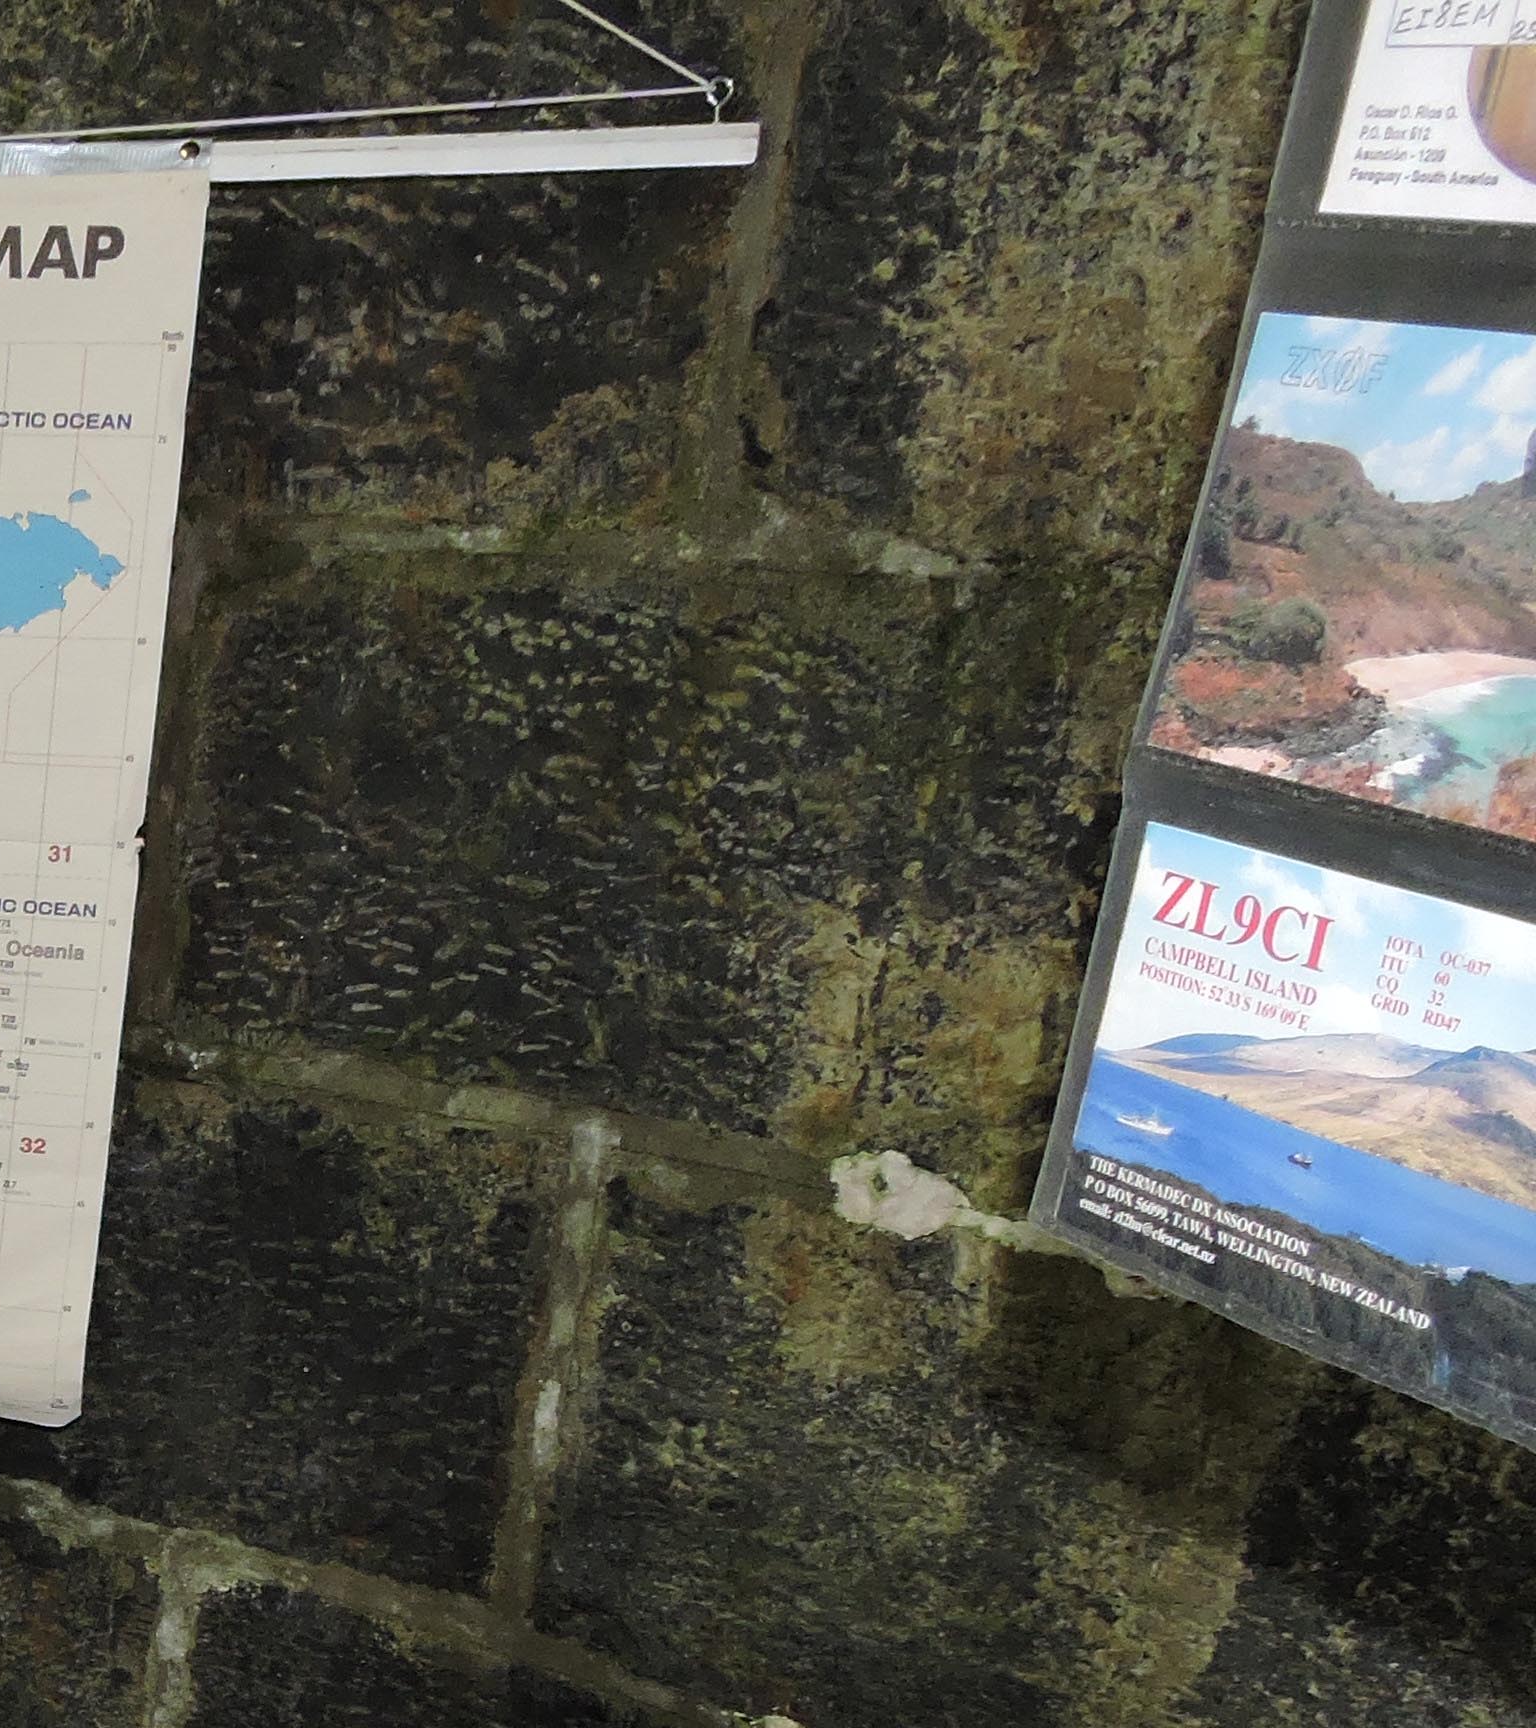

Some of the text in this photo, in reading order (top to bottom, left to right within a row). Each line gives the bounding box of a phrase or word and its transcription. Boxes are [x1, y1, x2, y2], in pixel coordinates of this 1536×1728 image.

[52, 412, 133, 430] OCEAN
[47, 845, 72, 863] 31
[24, 900, 97, 919] OCEAN
[1153, 871, 1336, 973] ZL9CI
[5, 940, 85, 961] Oceania
[1386, 936, 1423, 959] IOTA
[1145, 936, 1318, 1007] CAMPBELL ISLAND
[1381, 955, 1408, 974] ITU
[1139, 961, 1206, 996] POSITION:
[1376, 974, 1444, 1006] CQ 32
[1371, 993, 1461, 1032] GRID RD47
[20, 1136, 47, 1154] 32
[1089, 1156, 1117, 1178] THE
[1117, 1168, 1191, 1208] KERMADEC
[1192, 1197, 1213, 1217] DX
[1213, 1208, 1311, 1257] ASSOCIATION
[1085, 1175, 1095, 1189] P
[1095, 1179, 1106, 1194] O
[1106, 1183, 1134, 1208] BOX
[1171, 1211, 1215, 1244] TAWA,
[1216, 1230, 1316, 1286] WELLINGTON,
[1318, 1272, 1355, 1298] NEW
[1354, 1286, 1432, 1330] ZEALAND
